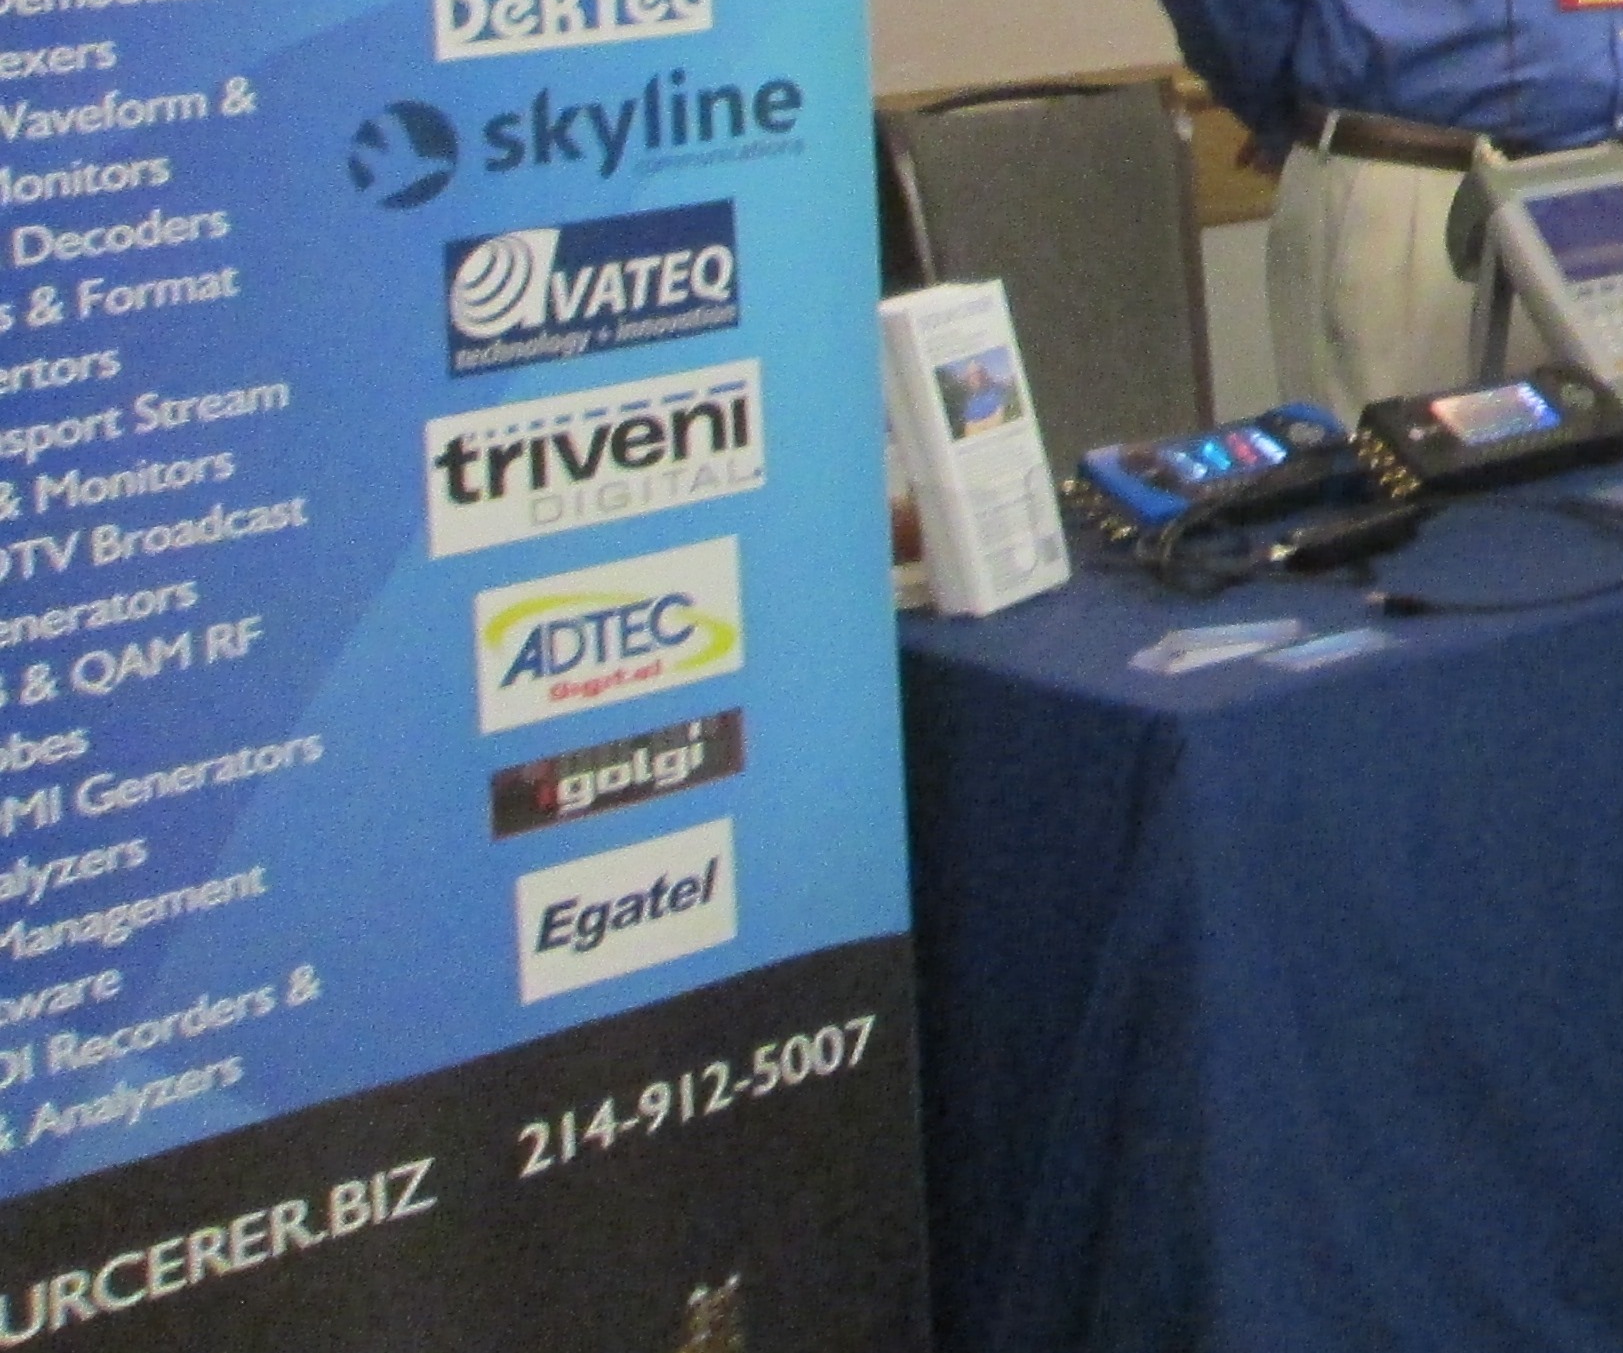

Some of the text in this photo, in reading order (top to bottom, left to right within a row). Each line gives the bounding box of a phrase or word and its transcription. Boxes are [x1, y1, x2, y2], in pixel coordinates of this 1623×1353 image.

[222, 76, 256, 116] &
[482, 68, 803, 178] skyline
[12, 209, 230, 268] Decoders
[27, 286, 64, 328] &
[78, 267, 240, 319] Format
[135, 382, 289, 433] Stream
[436, 396, 749, 505] triveni
[35, 452, 235, 513] Monitors
[530, 460, 753, 527] DIGITAL
[91, 497, 308, 565] Broadcast
[20, 663, 59, 705] &
[71, 631, 192, 695] QAM
[207, 615, 264, 664] RF
[500, 592, 696, 689] ADTEC
[77, 734, 323, 815] Generators
[557, 720, 704, 815] golgi
[536, 857, 719, 953] Egatel
[49, 985, 276, 1074] Recorders
[287, 963, 321, 1006] &
[28, 1055, 243, 1146] Analyzers
[0, 1015, 877, 1346] URCERER.BIZ 214-912-5007
